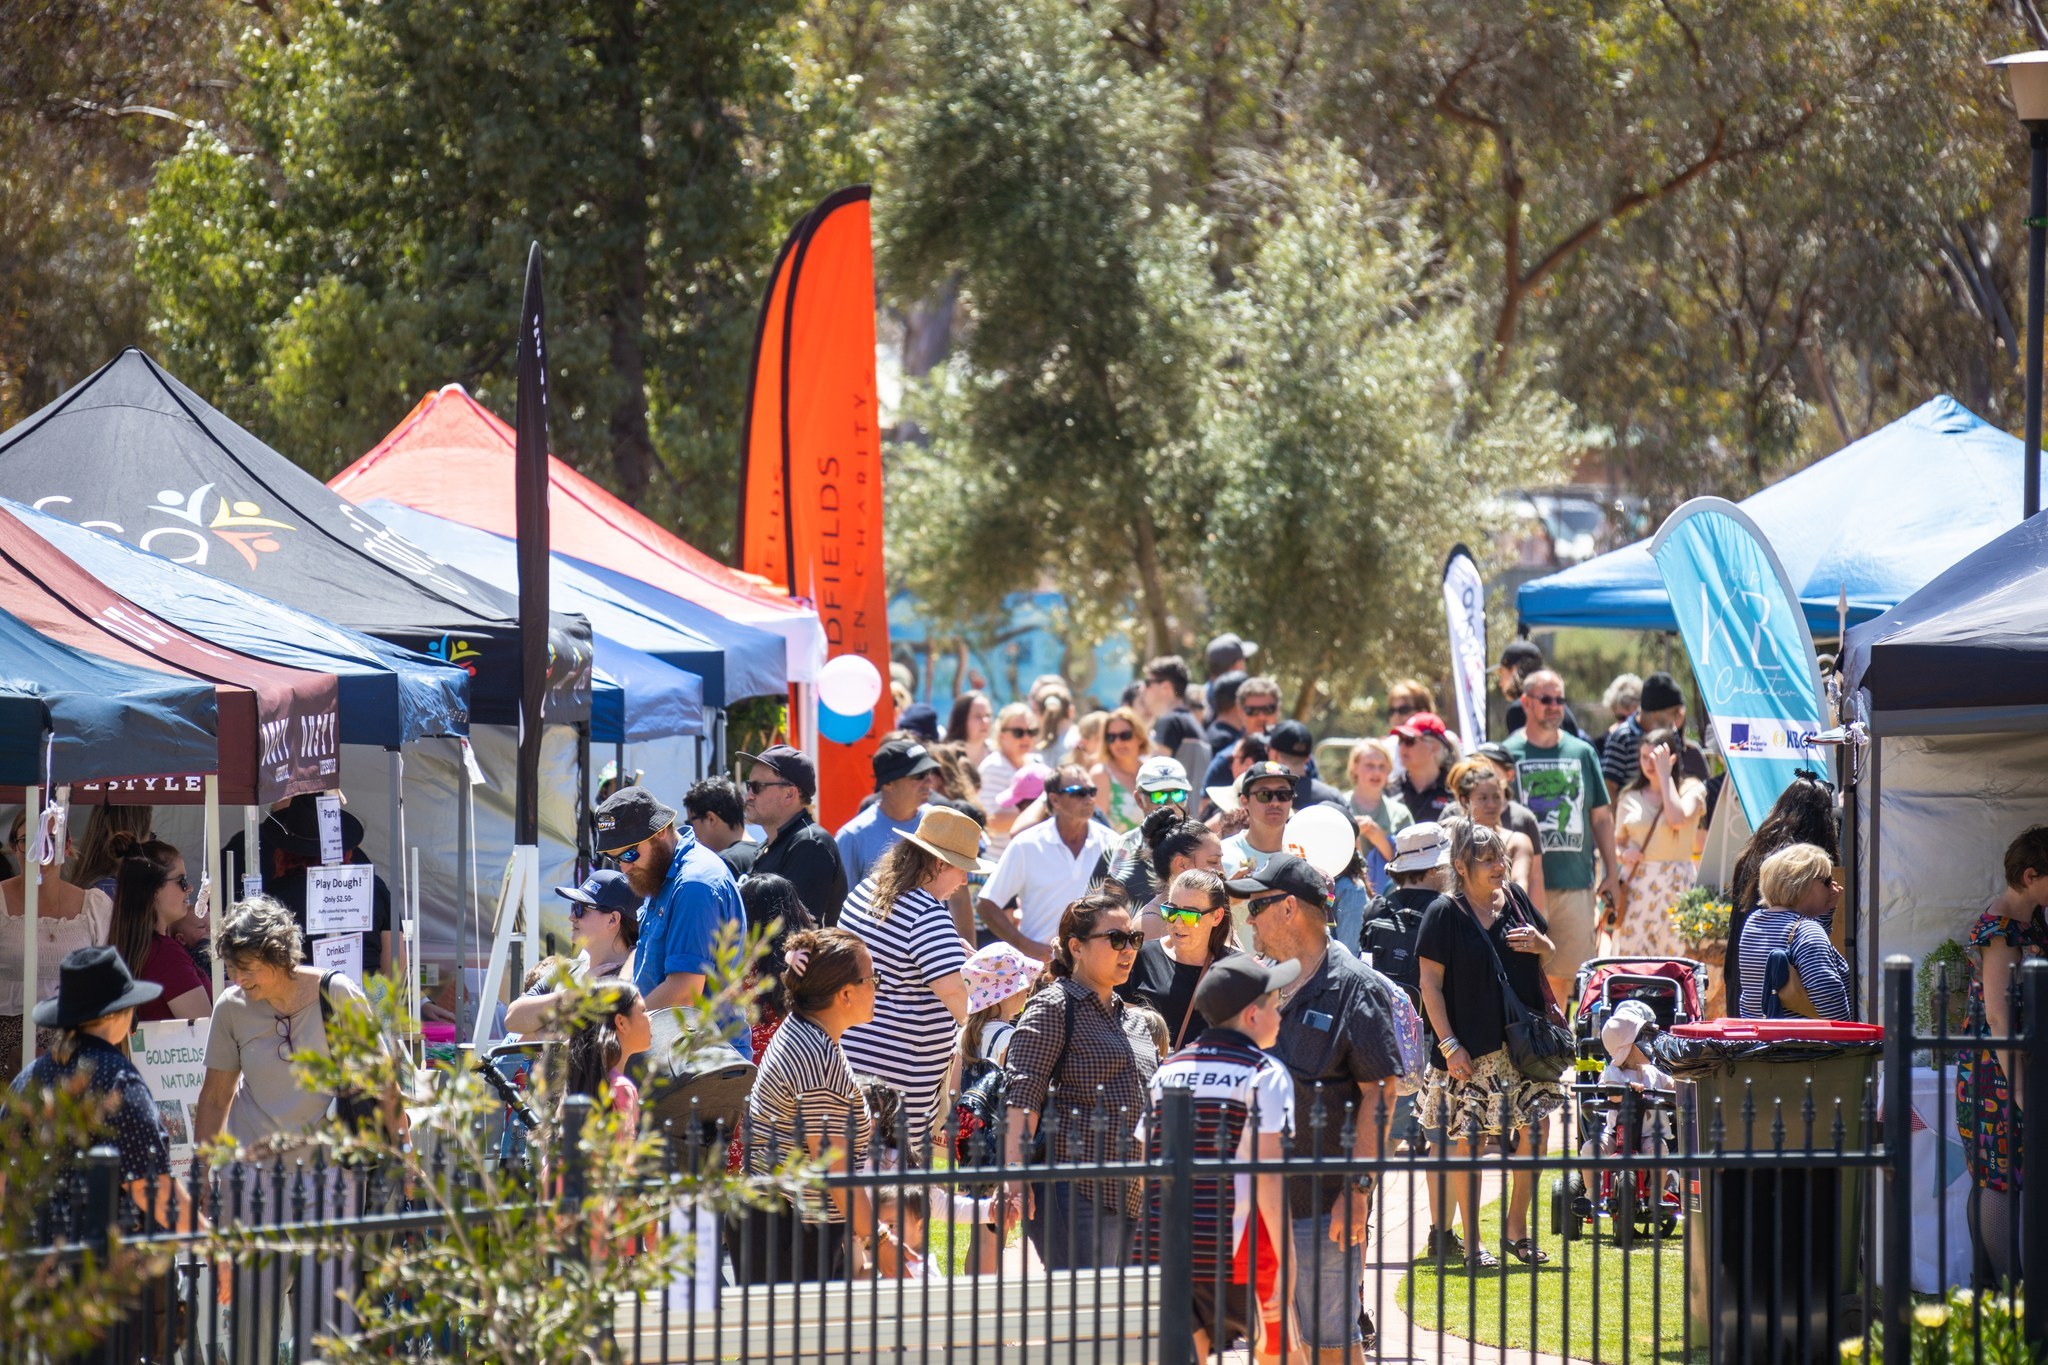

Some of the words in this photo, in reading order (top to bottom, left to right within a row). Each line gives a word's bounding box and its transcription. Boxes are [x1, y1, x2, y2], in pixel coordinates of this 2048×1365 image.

[817, 456, 845, 650] DFIELDS
[324, 809, 337, 819] Party
[316, 879, 331, 890] Play
[333, 877, 361, 889] Dough!
[145, 1047, 204, 1065] GOLDFIELDS
[1202, 1073, 1247, 1087] BAY
